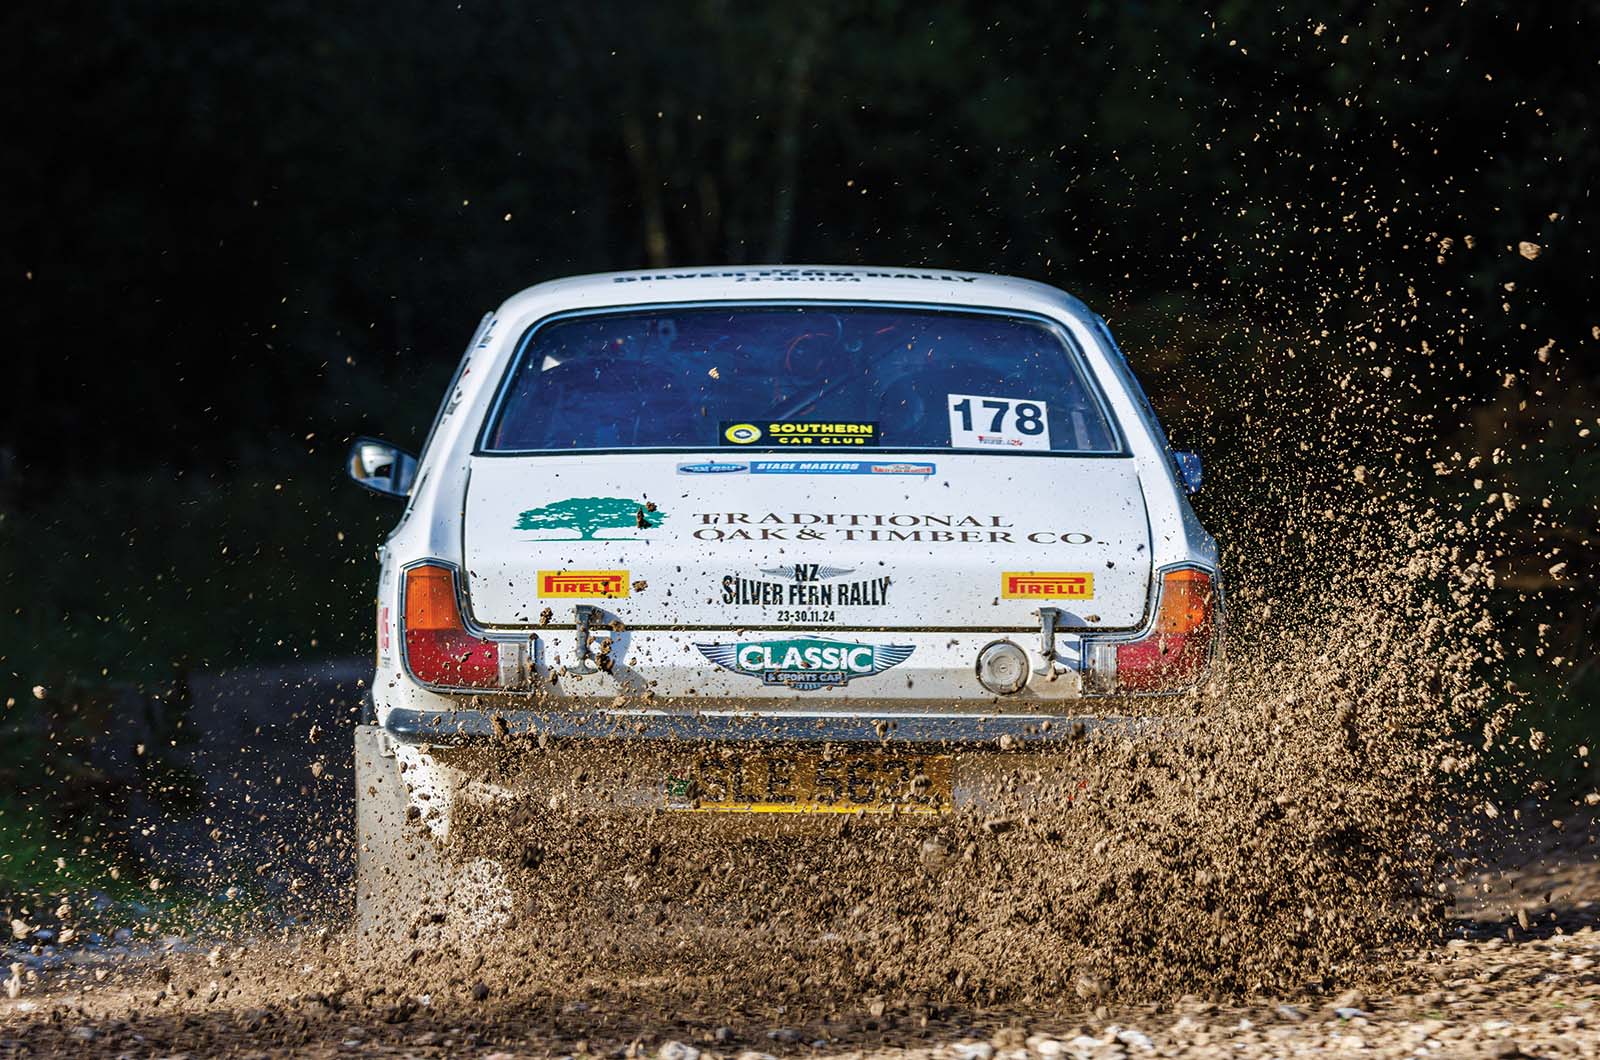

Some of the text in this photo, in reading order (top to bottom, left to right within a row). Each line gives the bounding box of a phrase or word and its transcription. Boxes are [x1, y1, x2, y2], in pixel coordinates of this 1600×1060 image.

[953, 398, 1045, 436] 178
[769, 423, 873, 434] SOUTHERN
[820, 437, 865, 445] CLUB
[692, 512, 1015, 528] TRADITIONAL
[692, 528, 790, 541] OAK
[836, 529, 1017, 544] TIMBER
[1026, 531, 1105, 545] CO.
[795, 564, 820, 581] NZ
[544, 575, 622, 593] PIRELLI
[722, 575, 890, 606] SILVER FERN RALLY
[1008, 576, 1087, 594] PIRELLI
[777, 610, 836, 622] 23-30.11.24
[738, 644, 873, 671] CLASSIC
[767, 673, 776, 681] &
[777, 672, 817, 681] SPORTS
